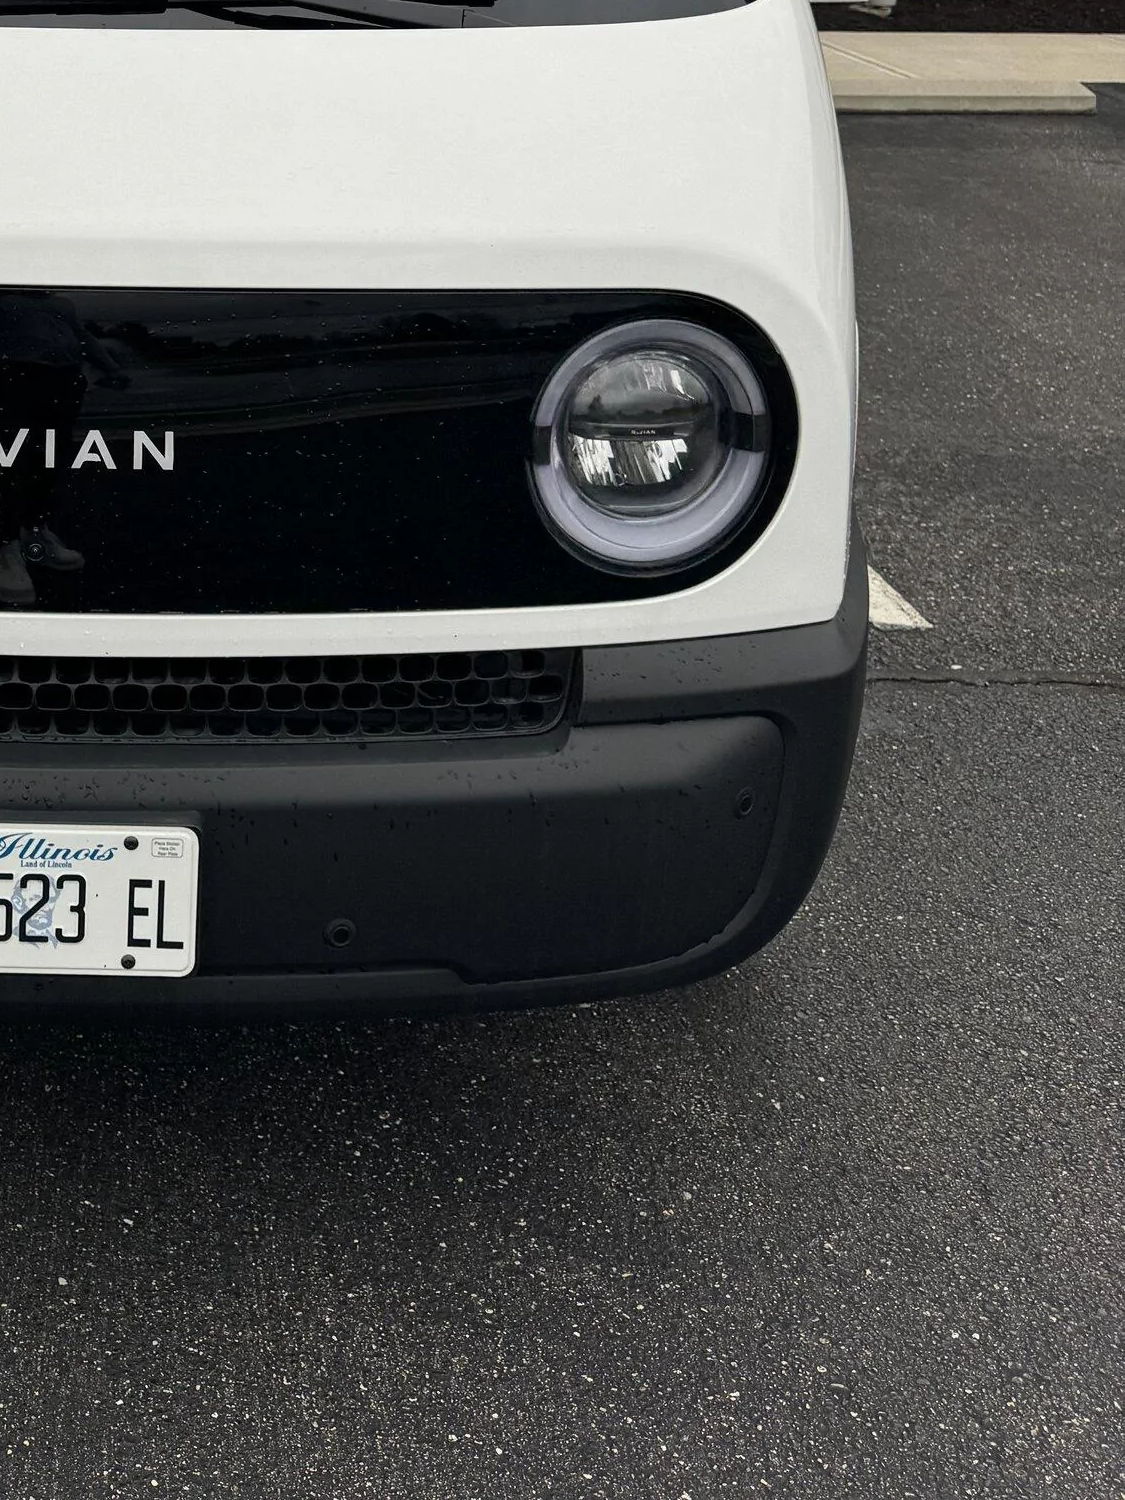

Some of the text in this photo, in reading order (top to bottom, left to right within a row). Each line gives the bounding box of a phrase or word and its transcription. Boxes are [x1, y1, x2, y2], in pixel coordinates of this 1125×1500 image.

[20, 860, 72, 868] Land of Lincoln
[128, 879, 184, 950] EL
